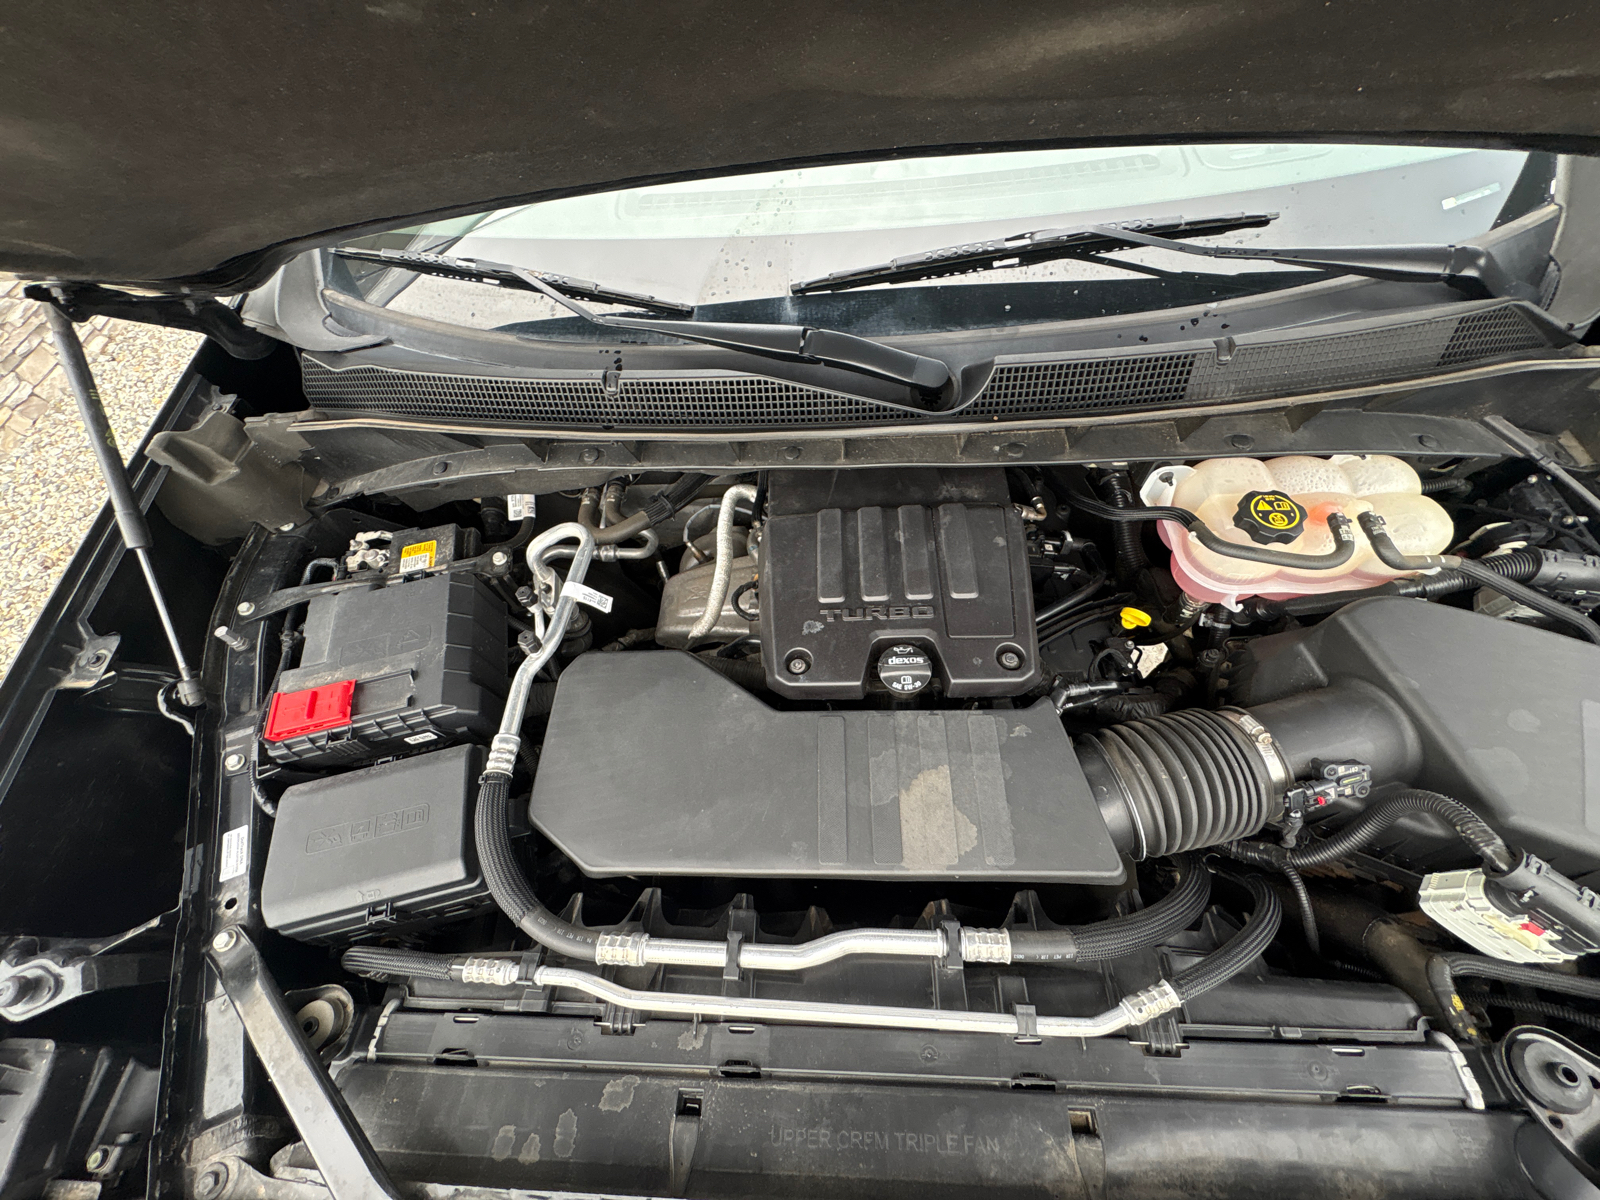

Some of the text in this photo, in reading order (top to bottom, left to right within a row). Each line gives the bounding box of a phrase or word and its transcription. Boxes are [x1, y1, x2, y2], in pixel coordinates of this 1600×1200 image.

[820, 606, 934, 622] TURBO
[888, 656, 924, 665] dexos
[770, 1125, 831, 1148] UPPER
[894, 1132, 960, 1154] TRIPLE
[963, 1135, 1000, 1154] FAN
